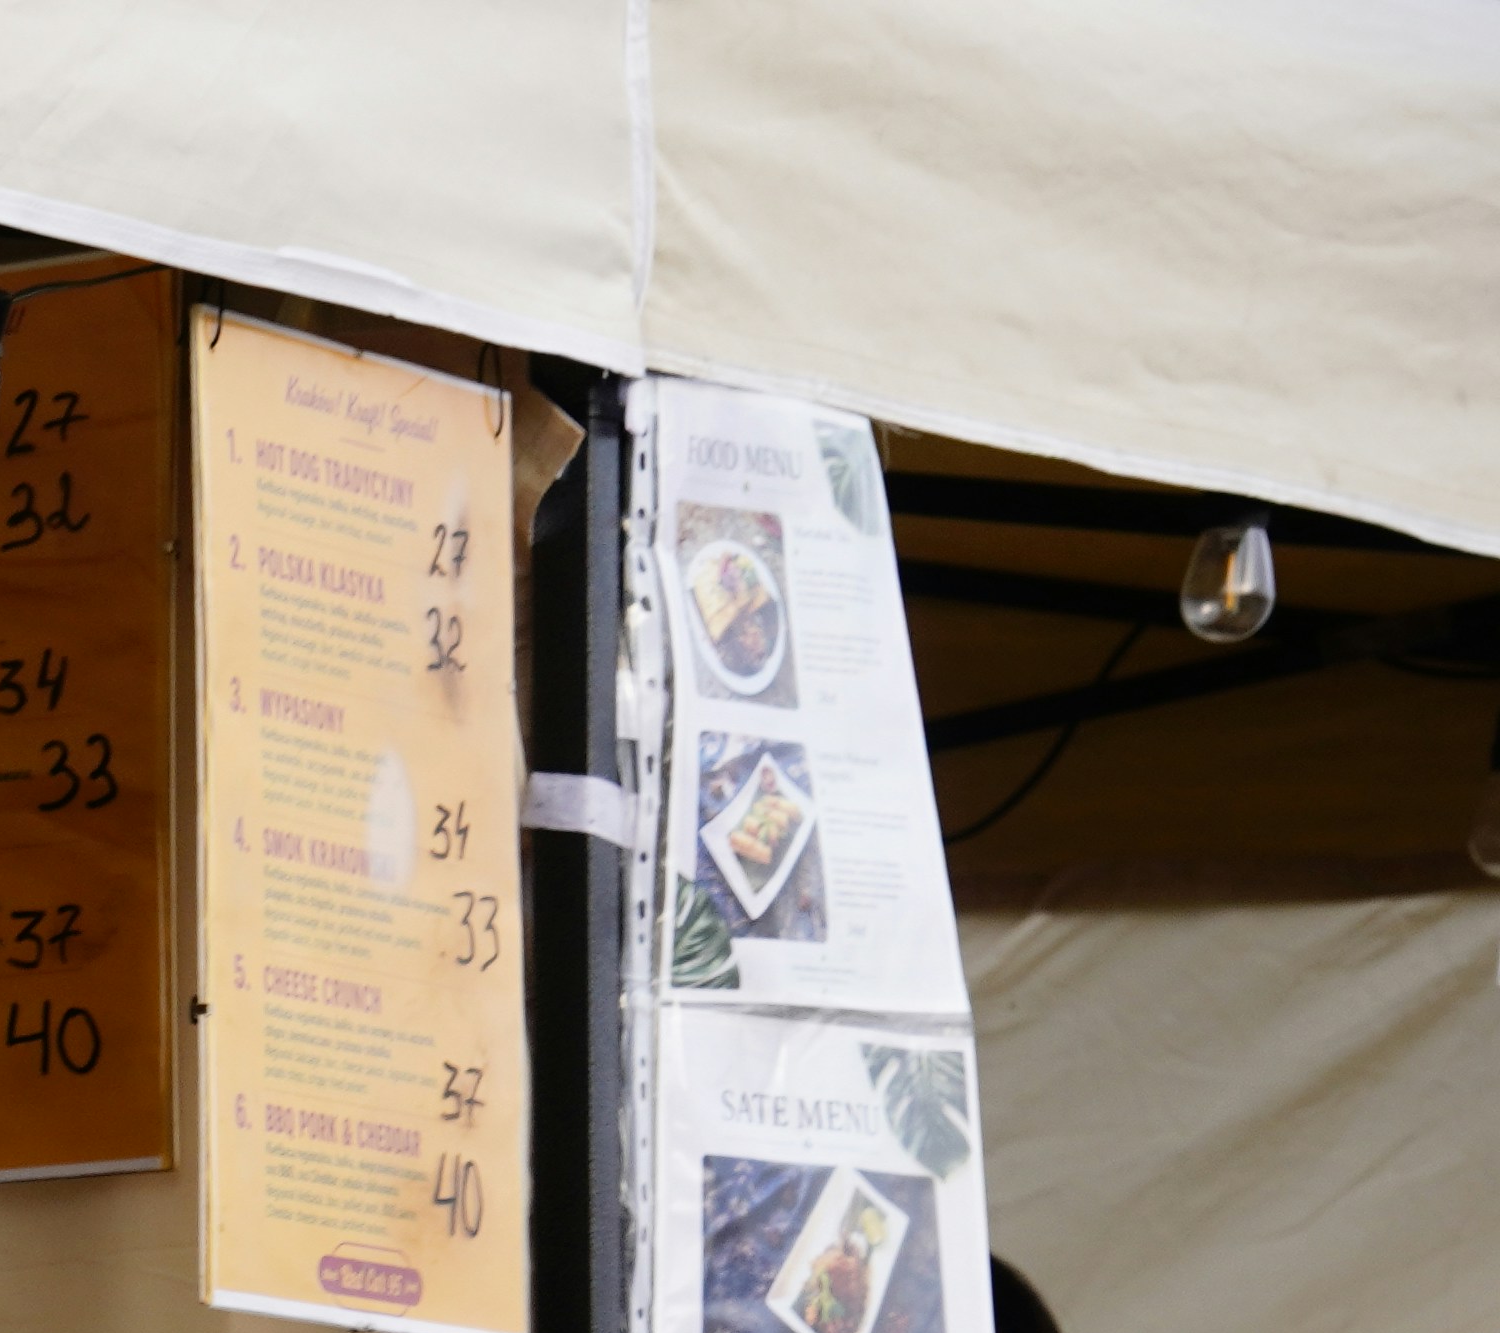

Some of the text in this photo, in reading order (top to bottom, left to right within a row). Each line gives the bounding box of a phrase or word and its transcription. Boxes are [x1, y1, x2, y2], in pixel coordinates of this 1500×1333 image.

[4, 388, 91, 459] 27
[687, 432, 804, 482] FOOD MENU
[1, 471, 93, 552] 32
[427, 523, 470, 578] 27
[426, 606, 468, 673] 32
[37, 733, 120, 813] 33
[429, 802, 471, 860] 34
[6, 904, 84, 970] 37
[452, 890, 501, 972] 33
[6, 1000, 102, 1076] 40
[441, 1060, 485, 1121] 37
[719, 1088, 883, 1138] SATE MENU
[432, 1152, 485, 1239] 40
